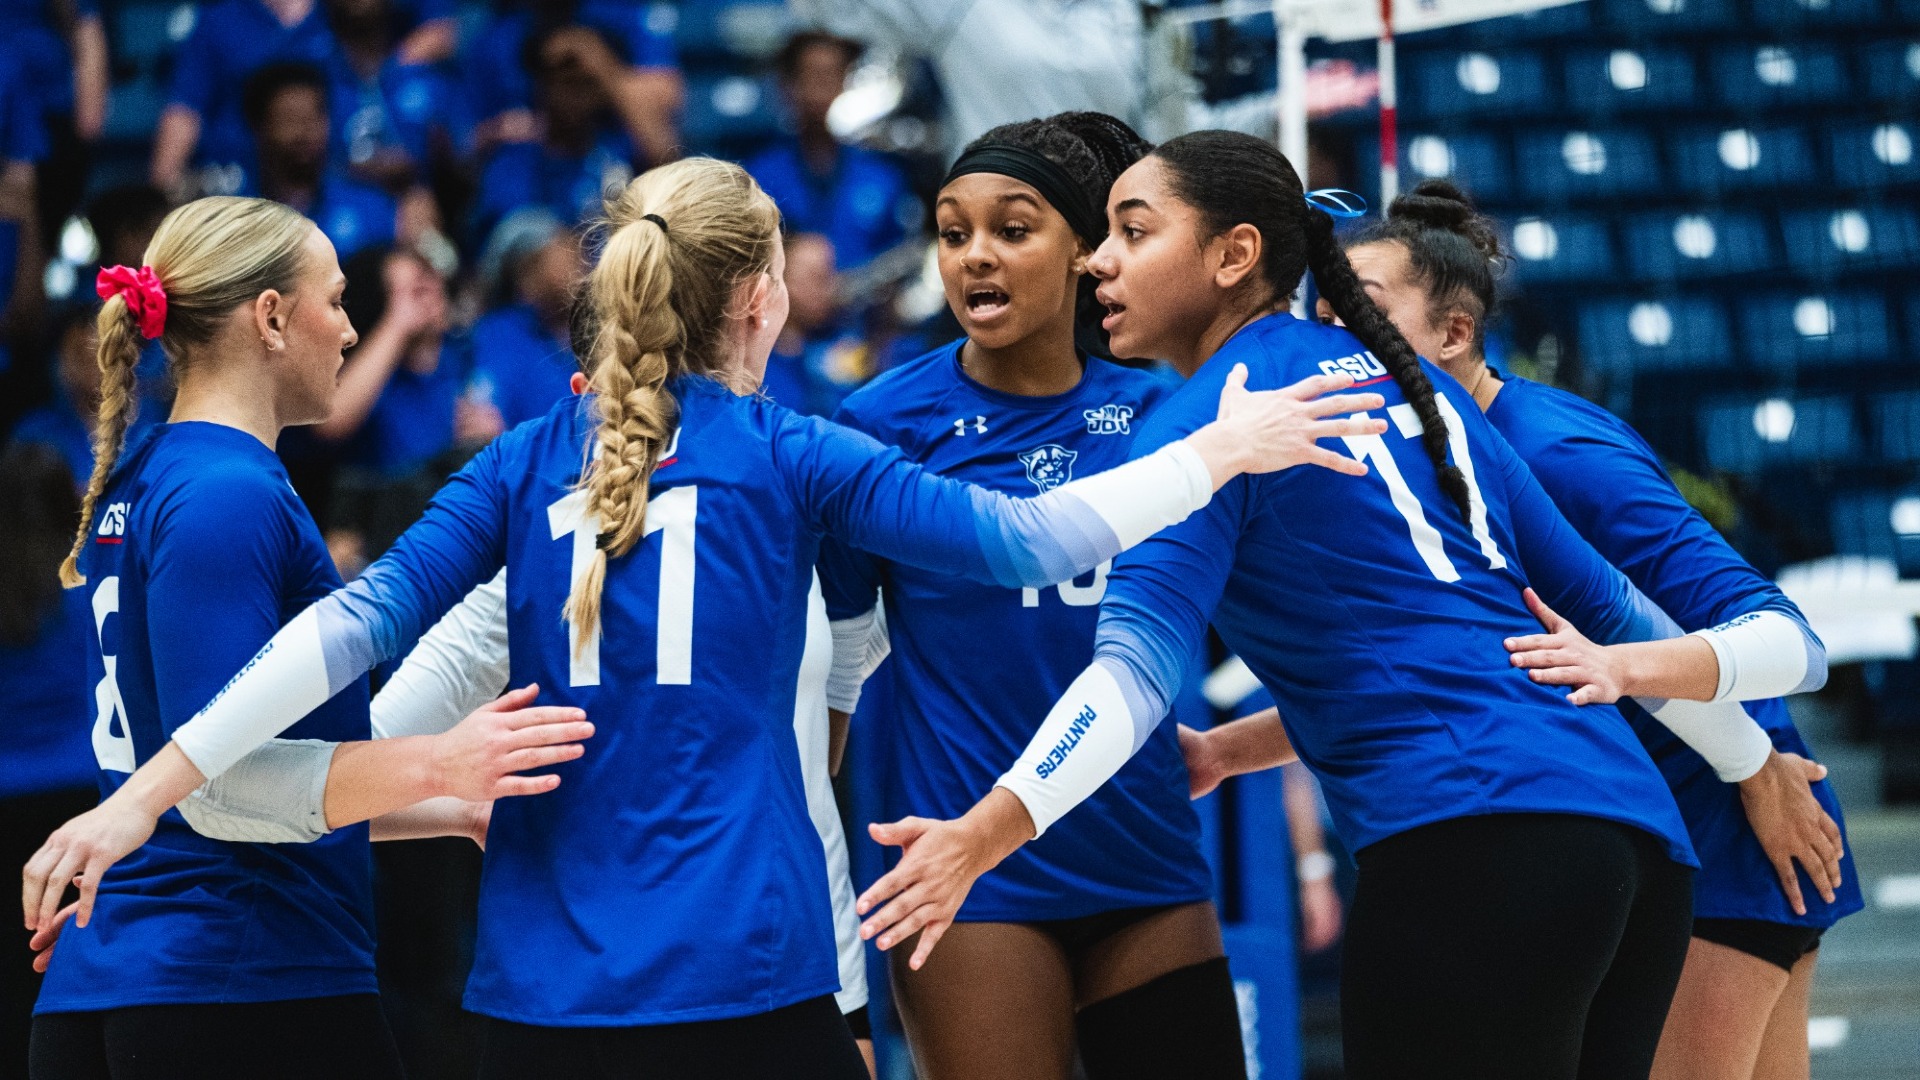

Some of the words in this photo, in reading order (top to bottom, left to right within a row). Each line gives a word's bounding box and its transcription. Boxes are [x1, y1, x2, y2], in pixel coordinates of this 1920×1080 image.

[1317, 350, 1388, 381] GSU
[1340, 391, 1508, 584] 17
[547, 484, 698, 688] 11
[1035, 703, 1098, 780] PANTHERS
